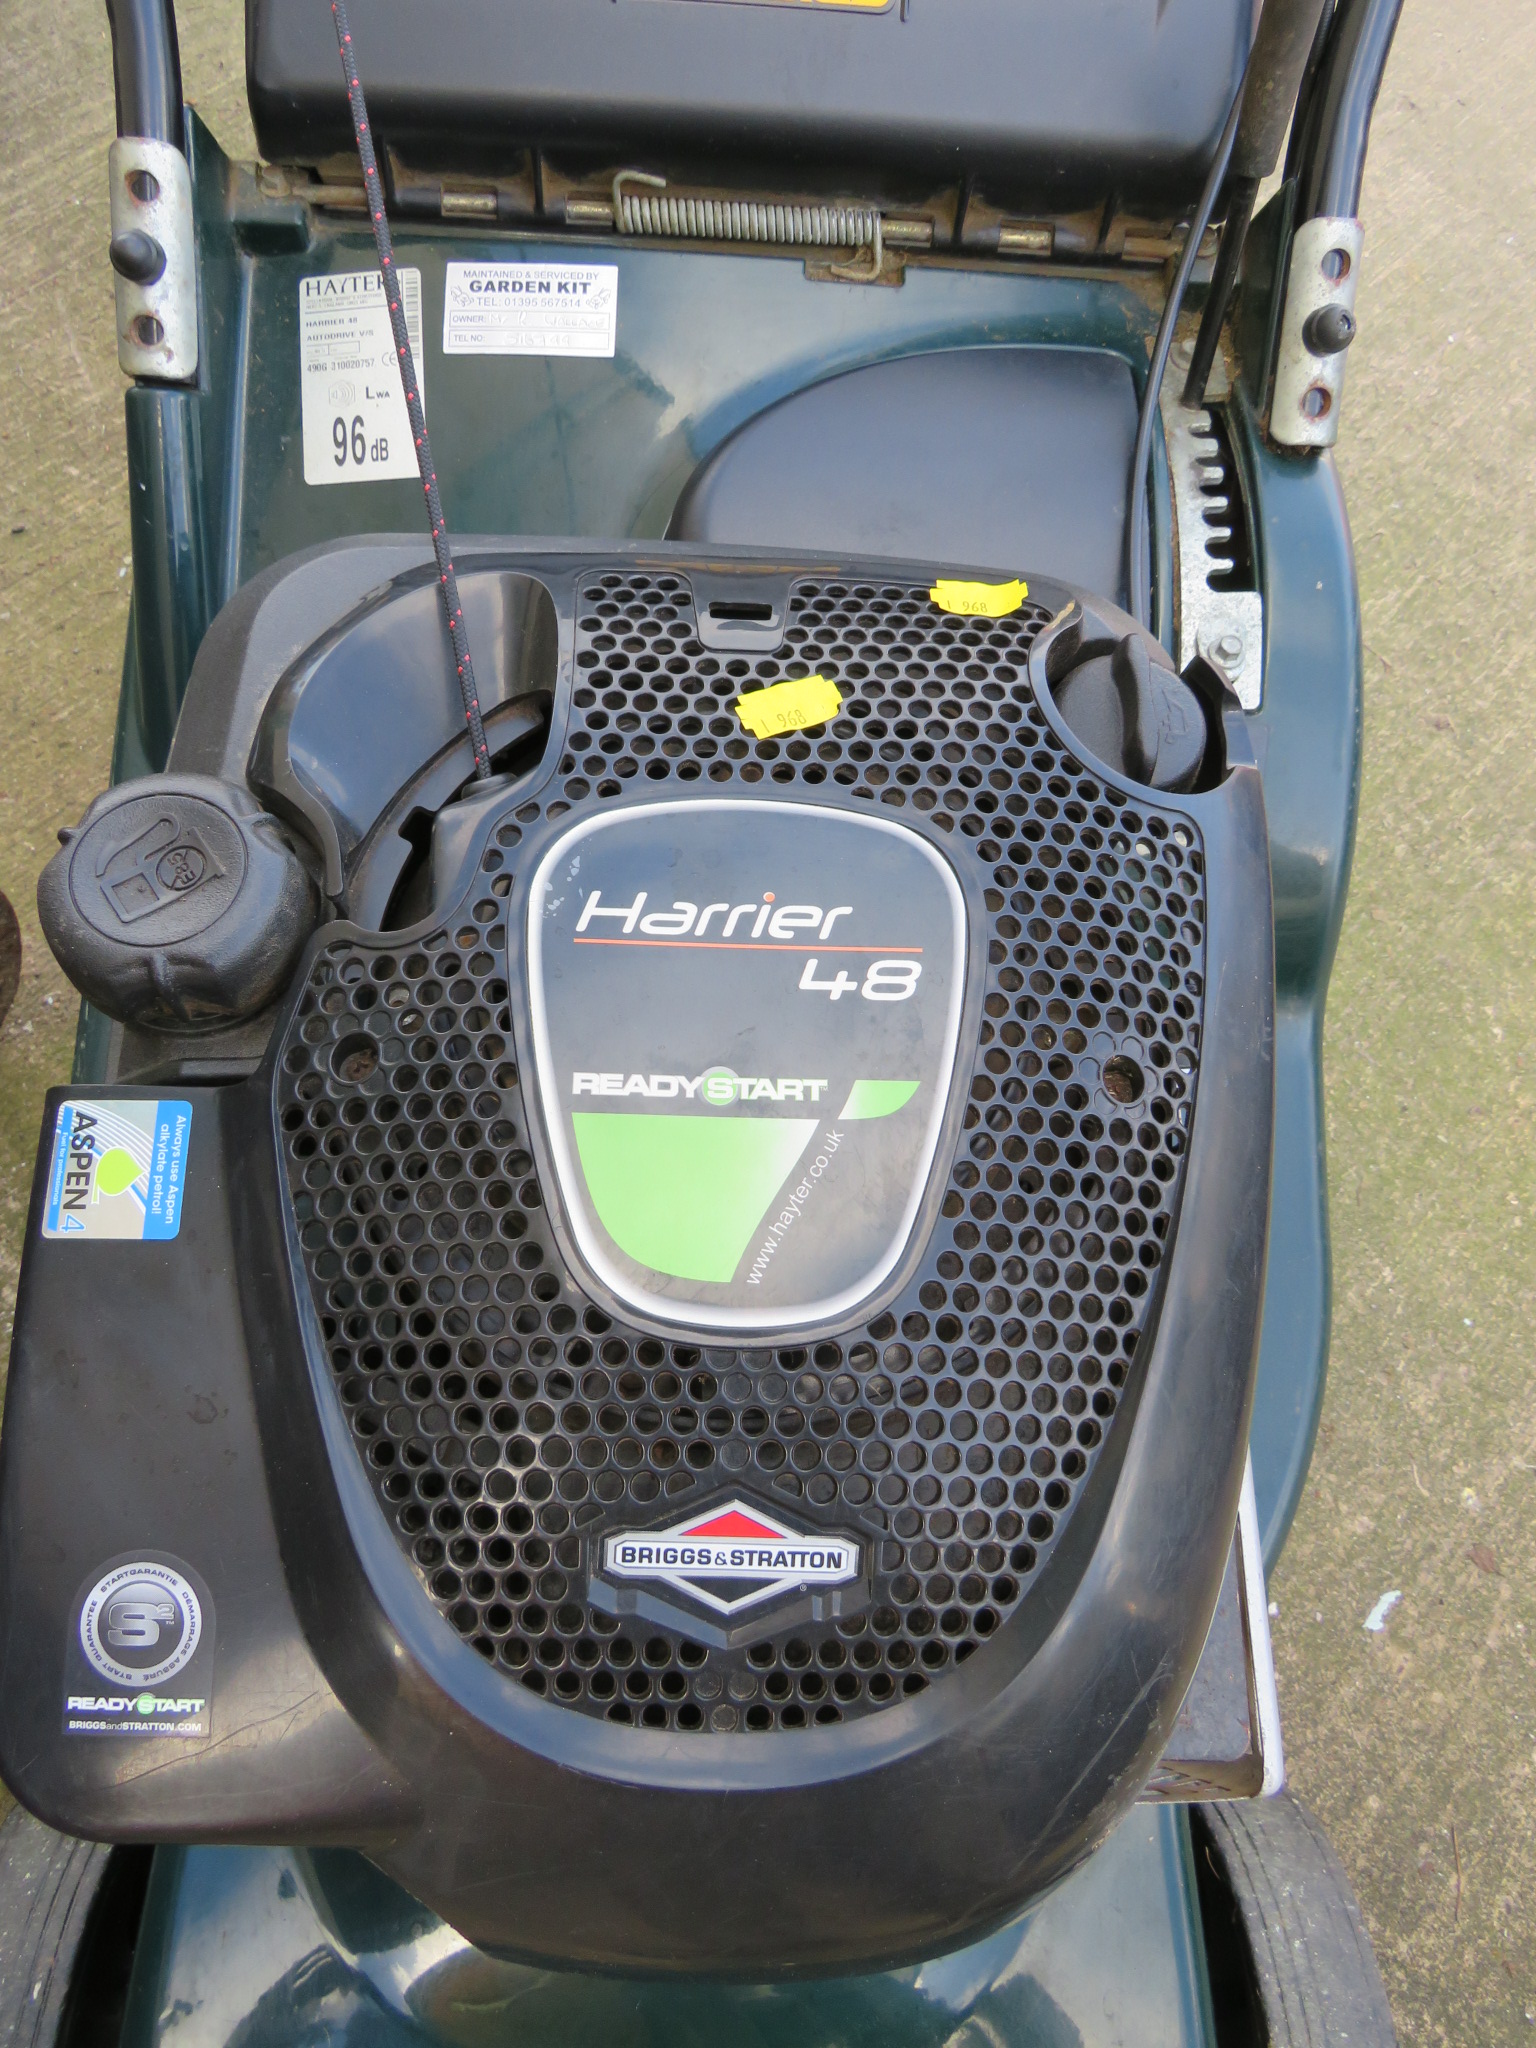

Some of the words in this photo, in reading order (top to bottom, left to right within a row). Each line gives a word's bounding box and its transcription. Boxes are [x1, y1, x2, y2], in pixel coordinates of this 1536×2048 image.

[463, 270, 523, 279] MAINTAINED
[525, 271, 531, 279] &
[534, 272, 584, 280] SERVICED
[586, 272, 599, 281] BY
[469, 280, 550, 293] GARDEN
[558, 281, 591, 294] KIT
[504, 297, 538, 307] 01395
[540, 298, 581, 308] 567514
[306, 318, 344, 328] HARRIER
[453, 315, 486, 323] OWNER:
[306, 332, 357, 342] AUTODRIVE
[454, 334, 468, 342] TEL
[333, 415, 366, 466] 96
[371, 438, 389, 462] dB
[962, 600, 988, 613] 968
[777, 709, 807, 728] 968
[575, 890, 853, 940] Harrier
[798, 958, 923, 1001] 48
[172, 1115, 186, 1157] Always
[157, 1124, 170, 1172] alkylate
[63, 1111, 98, 1209] ASPEN
[170, 1160, 181, 1182] use
[53, 1158, 63, 1206] professionals
[151, 1175, 163, 1214] petrol!
[165, 1185, 179, 1224] Aspen
[746, 1129, 845, 1286] www.hayter.co.uk
[60, 1213, 85, 1233] 4
[102, 1663, 132, 1680] START
[69, 1721, 201, 1731] BRIGGSandSTRATTON.COM
